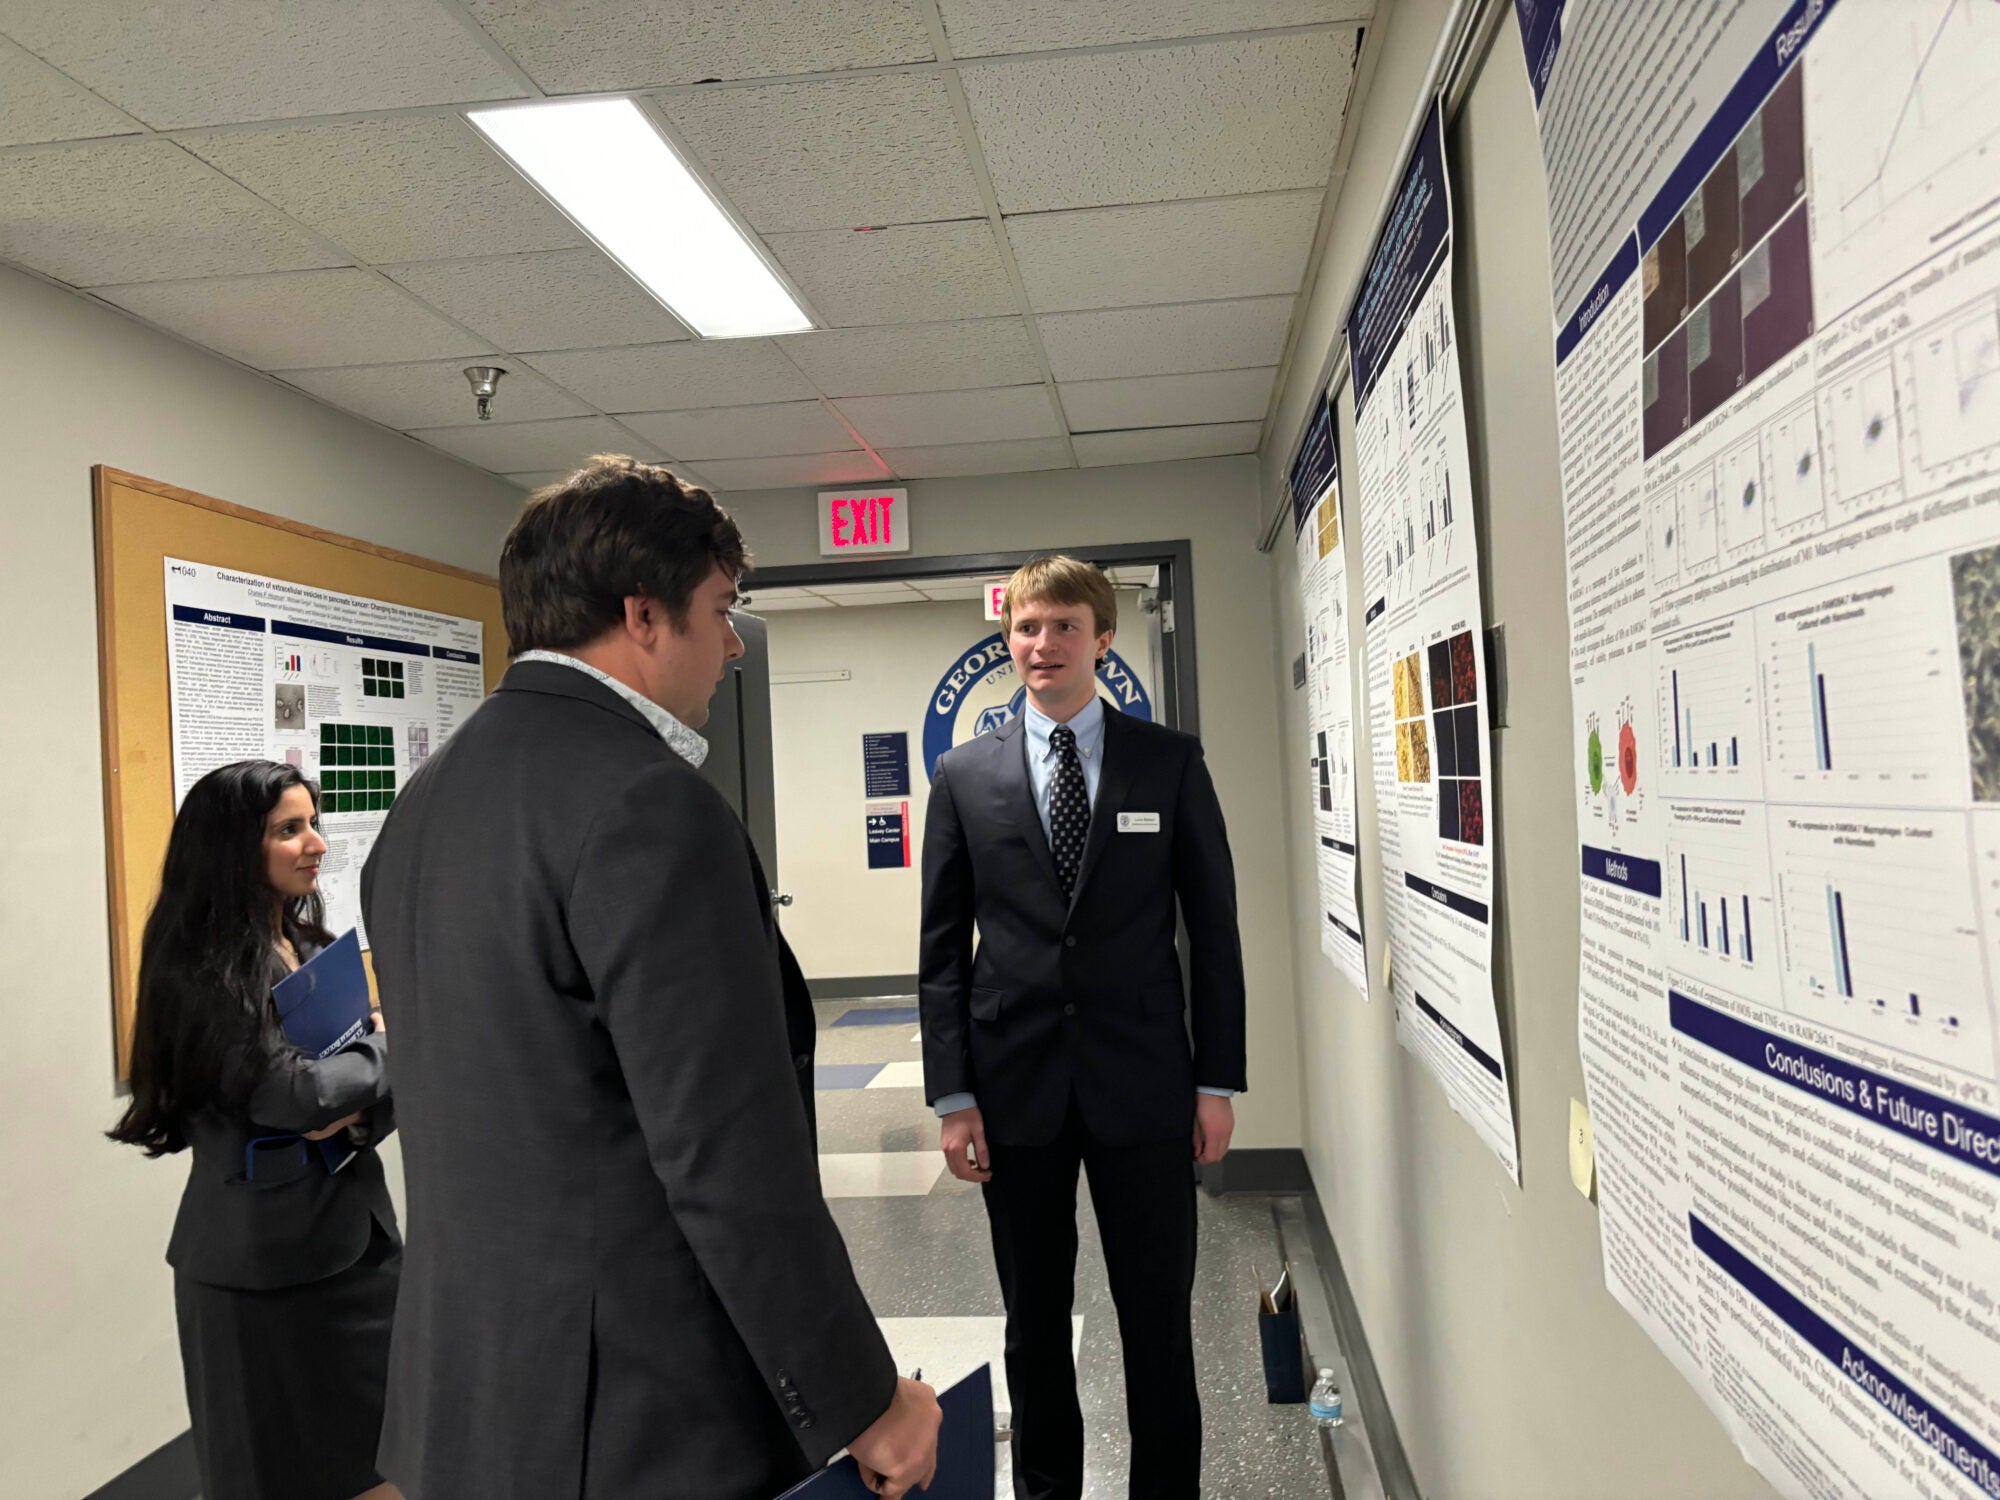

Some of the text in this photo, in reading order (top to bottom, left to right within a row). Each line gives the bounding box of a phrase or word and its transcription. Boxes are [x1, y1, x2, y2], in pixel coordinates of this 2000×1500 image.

[1578, 283, 1610, 333] Introduction
[831, 497, 895, 547] EXIT
[217, 572, 265, 588] Characterization
[272, 584, 303, 597] extracellular
[204, 612, 232, 624] Abstract
[346, 634, 364, 646] Results
[869, 827, 885, 835] Leavey
[881, 837, 900, 845] Campus
[1605, 857, 1628, 882] Methods
[1765, 1042, 2000, 1164] Conclusions & Future Direc
[1842, 1346, 2000, 1496] Acknowledgments
